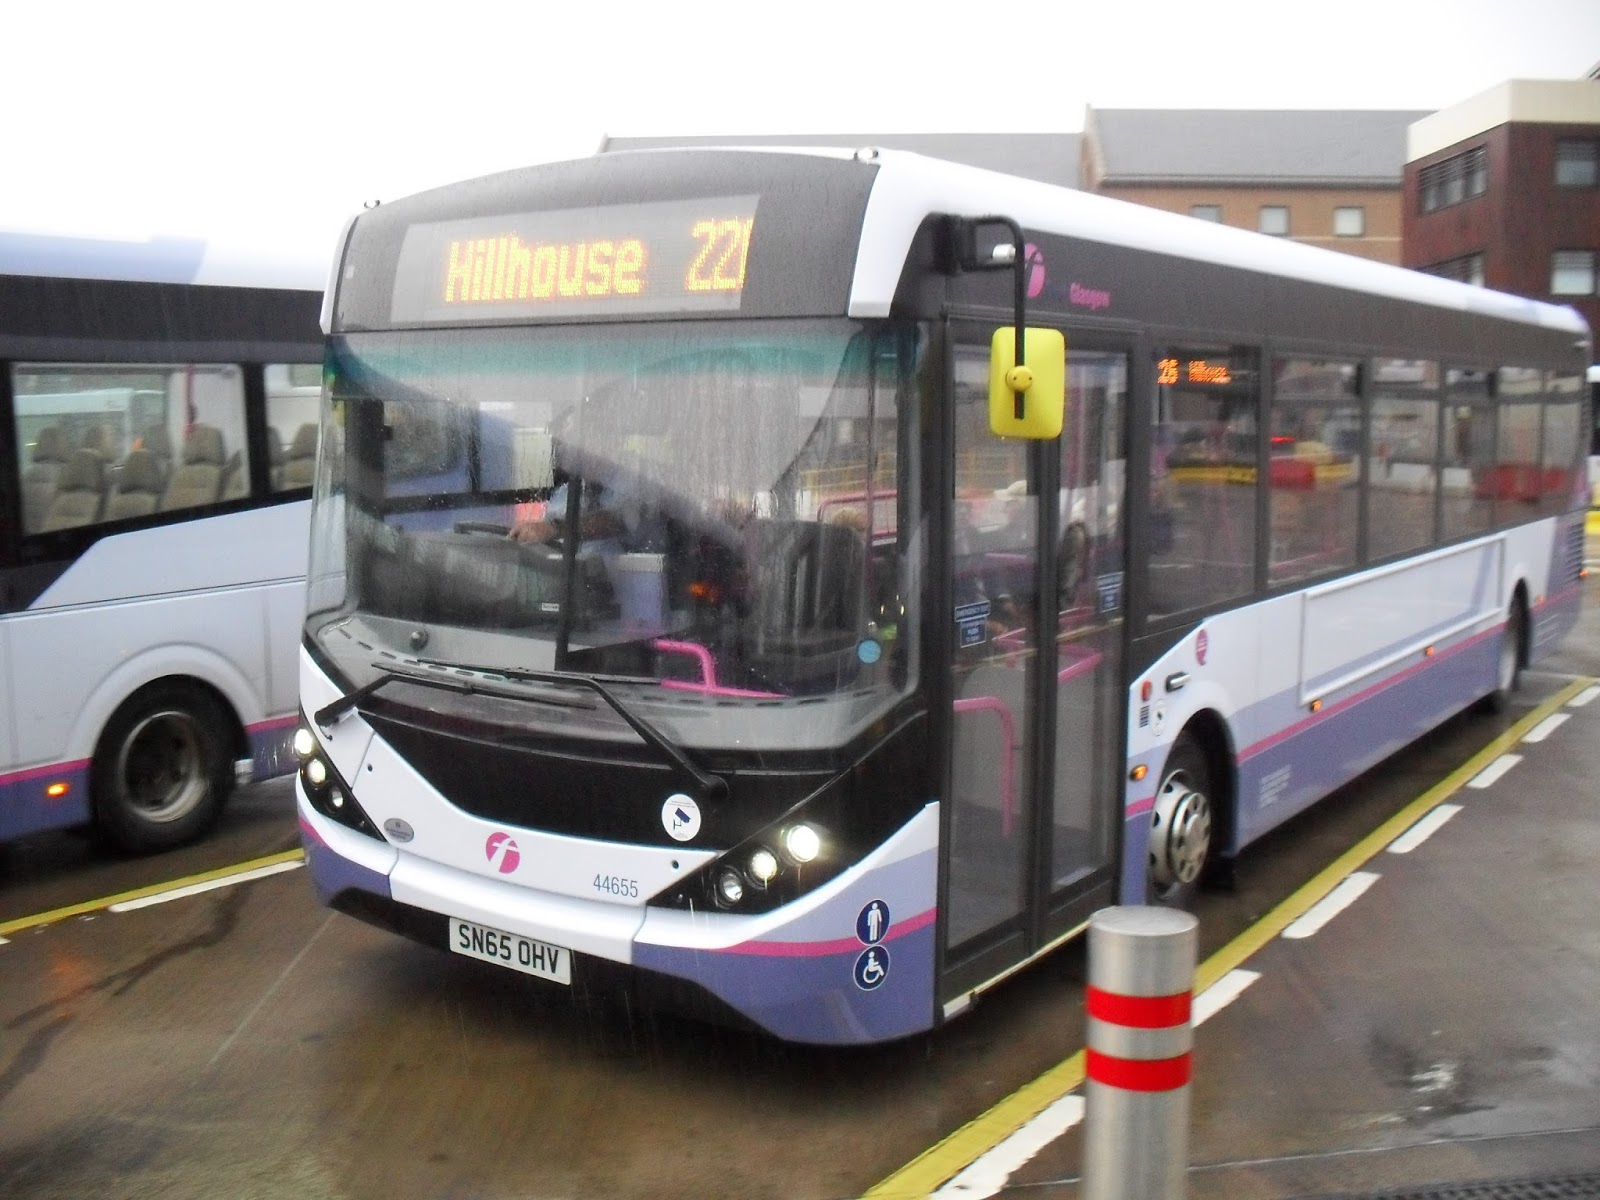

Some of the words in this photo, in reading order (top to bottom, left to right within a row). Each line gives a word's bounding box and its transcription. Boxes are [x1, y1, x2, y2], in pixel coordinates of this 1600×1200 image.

[445, 233, 644, 303] Hillhouse
[593, 873, 639, 898] 44655
[459, 924, 512, 961] SN65
[518, 940, 559, 974] OHV
